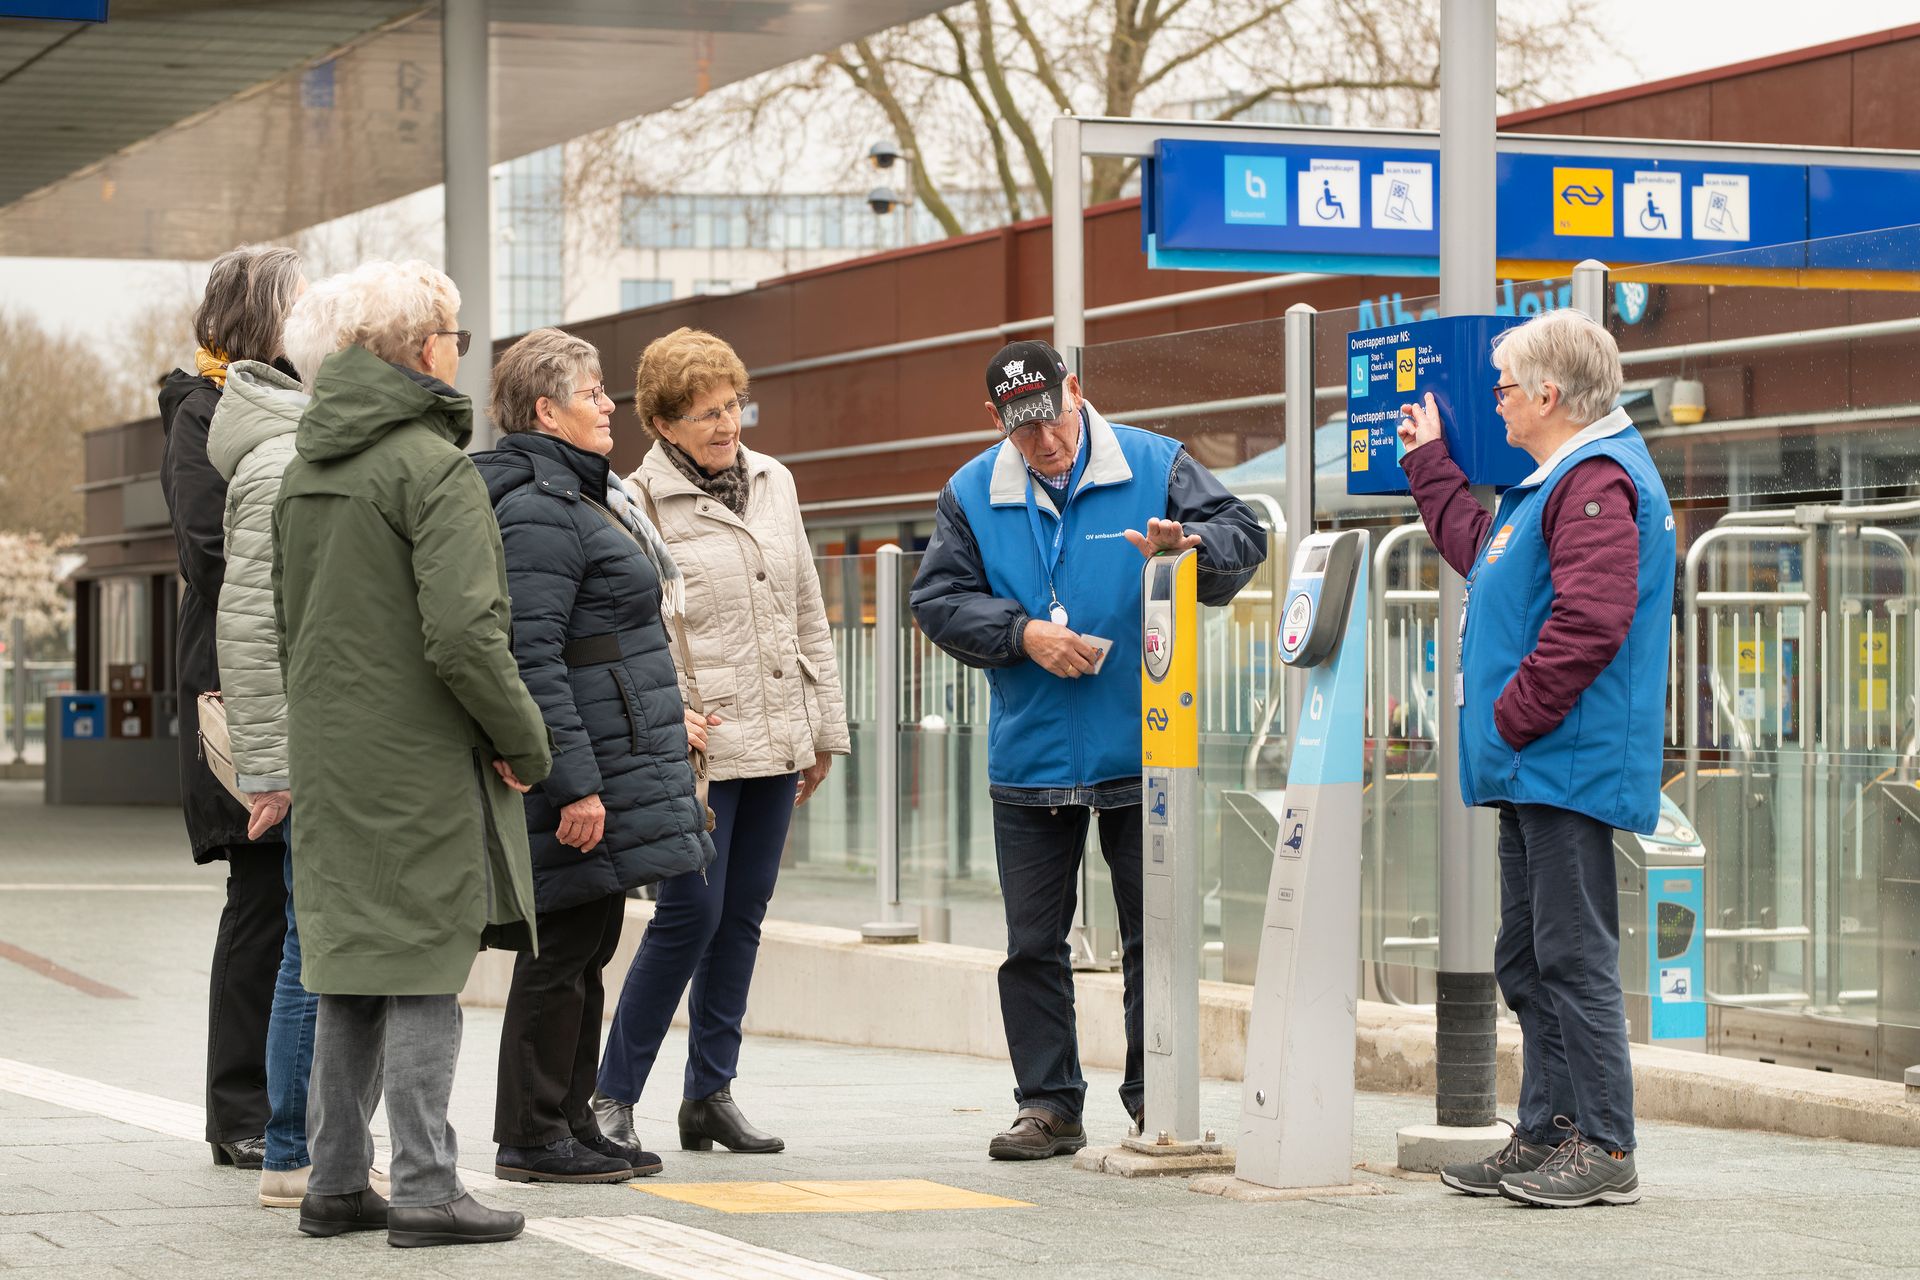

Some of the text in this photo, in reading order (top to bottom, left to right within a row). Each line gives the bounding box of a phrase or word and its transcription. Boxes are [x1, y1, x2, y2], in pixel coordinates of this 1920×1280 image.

[1312, 164, 1354, 173] gehandicapt
[1351, 331, 1411, 350] Overstappen naar NS:
[1418, 346, 1427, 355] Stap
[1371, 353, 1380, 362] Stap
[1418, 356, 1430, 365] Check
[1431, 355, 1435, 363] in
[1371, 363, 1382, 372] Check
[1418, 367, 1424, 375] NS
[1371, 373, 1389, 382] blauwnet
[995, 371, 1047, 397] PRAHA
[1351, 410, 1386, 424] Overstappen
[1386, 409, 1400, 419] naar
[1371, 428, 1380, 437] Stap
[1371, 438, 1382, 446] Check
[1371, 448, 1377, 456] NS
[1094, 531, 1125, 540] ambassade
[1146, 751, 1153, 761] NS
